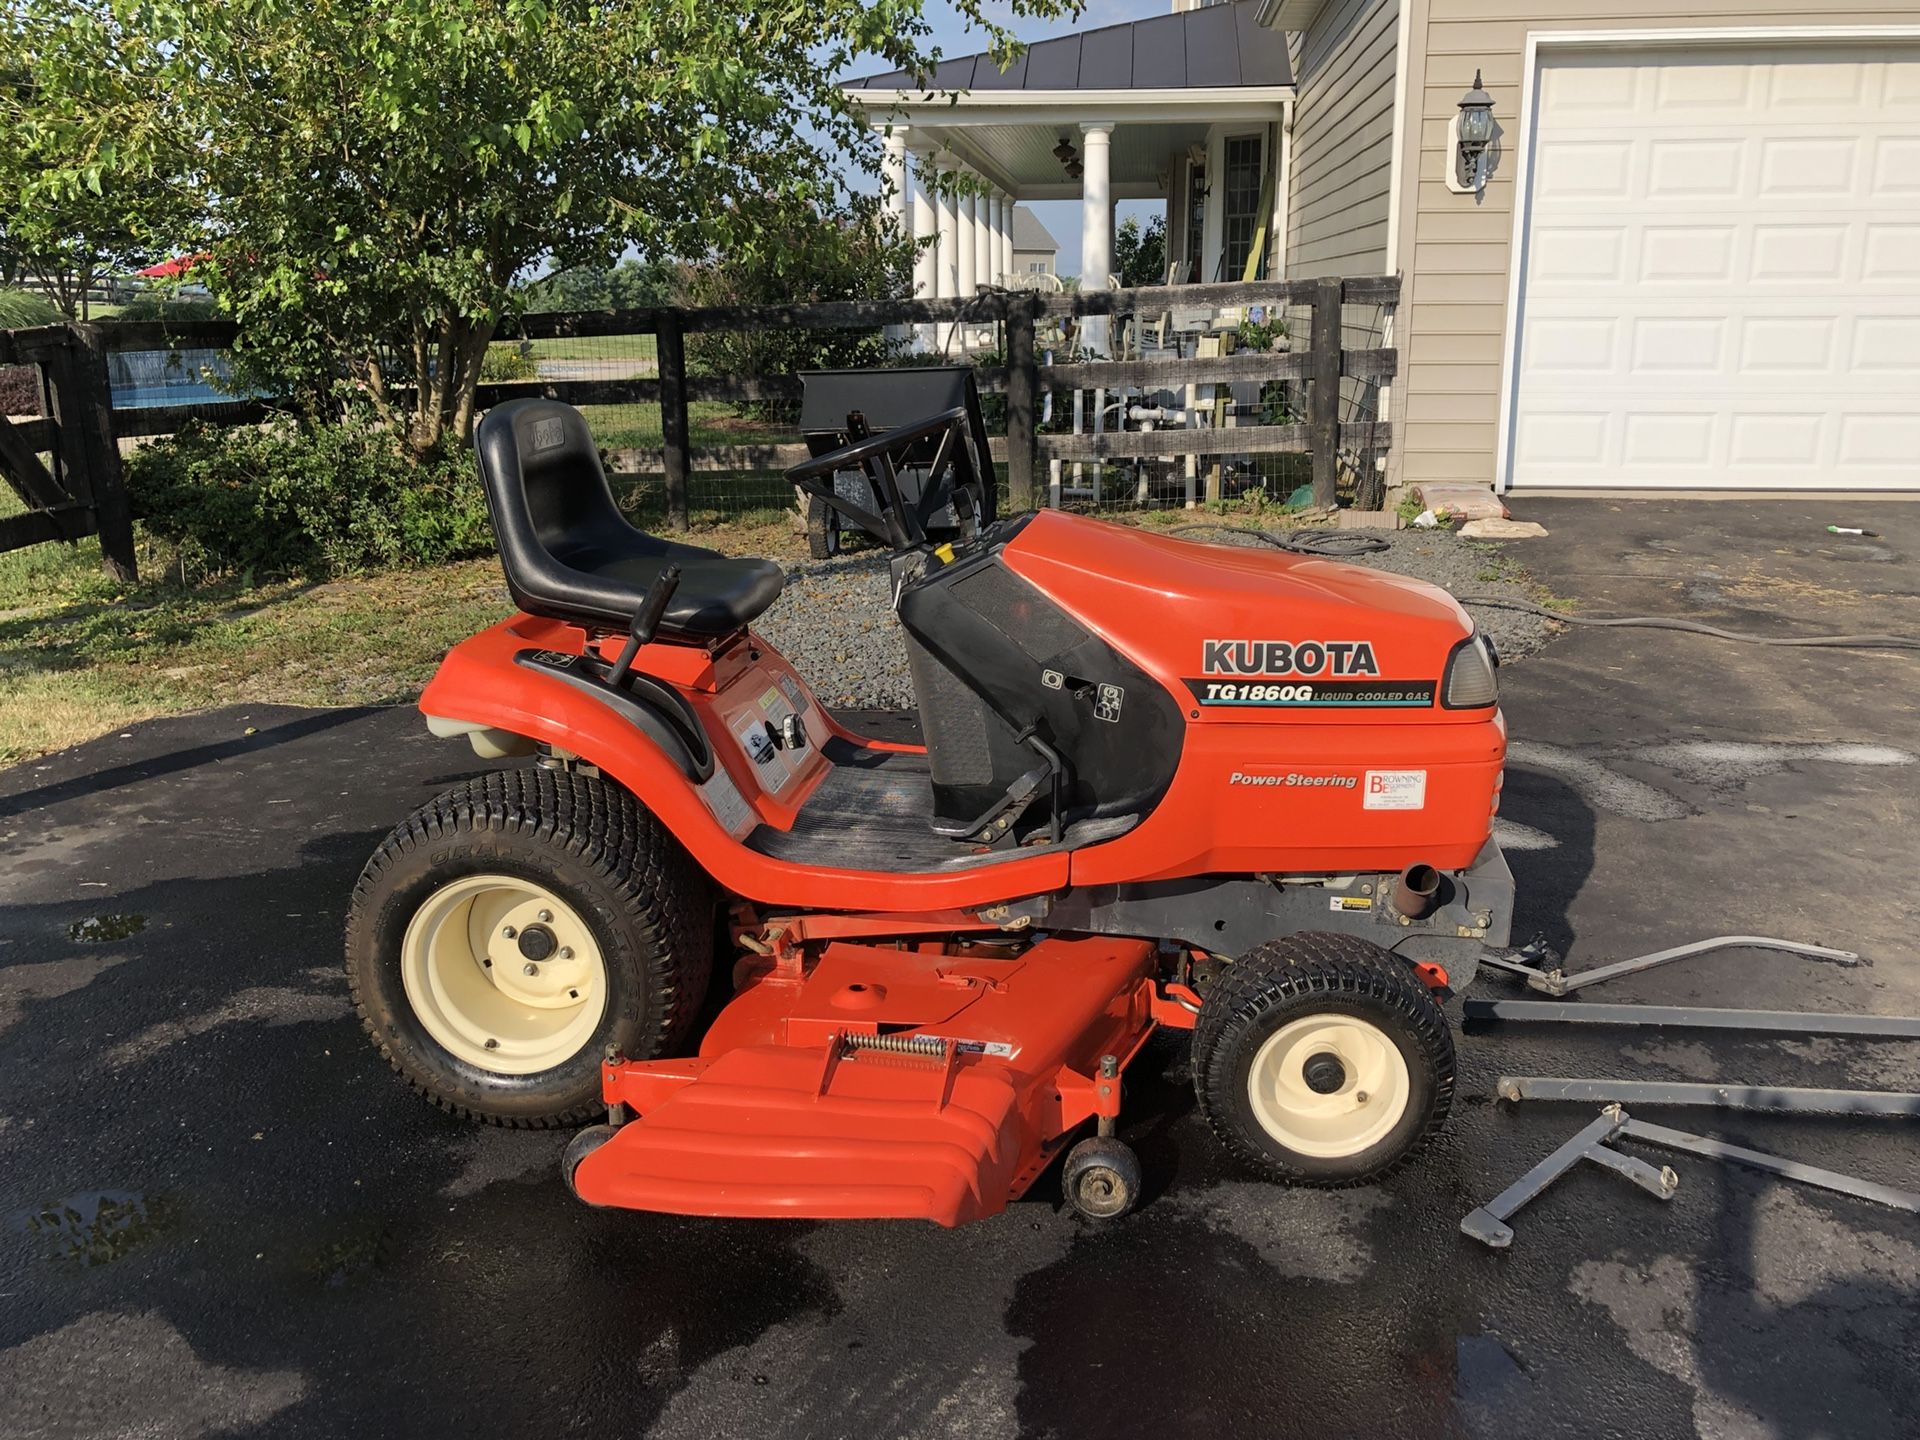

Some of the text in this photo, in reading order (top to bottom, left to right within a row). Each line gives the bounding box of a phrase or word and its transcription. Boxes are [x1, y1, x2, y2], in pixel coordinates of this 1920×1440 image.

[1203, 640, 1381, 677] KUBOTA
[1206, 684, 1430, 702] TG1860G LIQUID COOLED GAS
[1229, 772, 1358, 789] Power Steering
